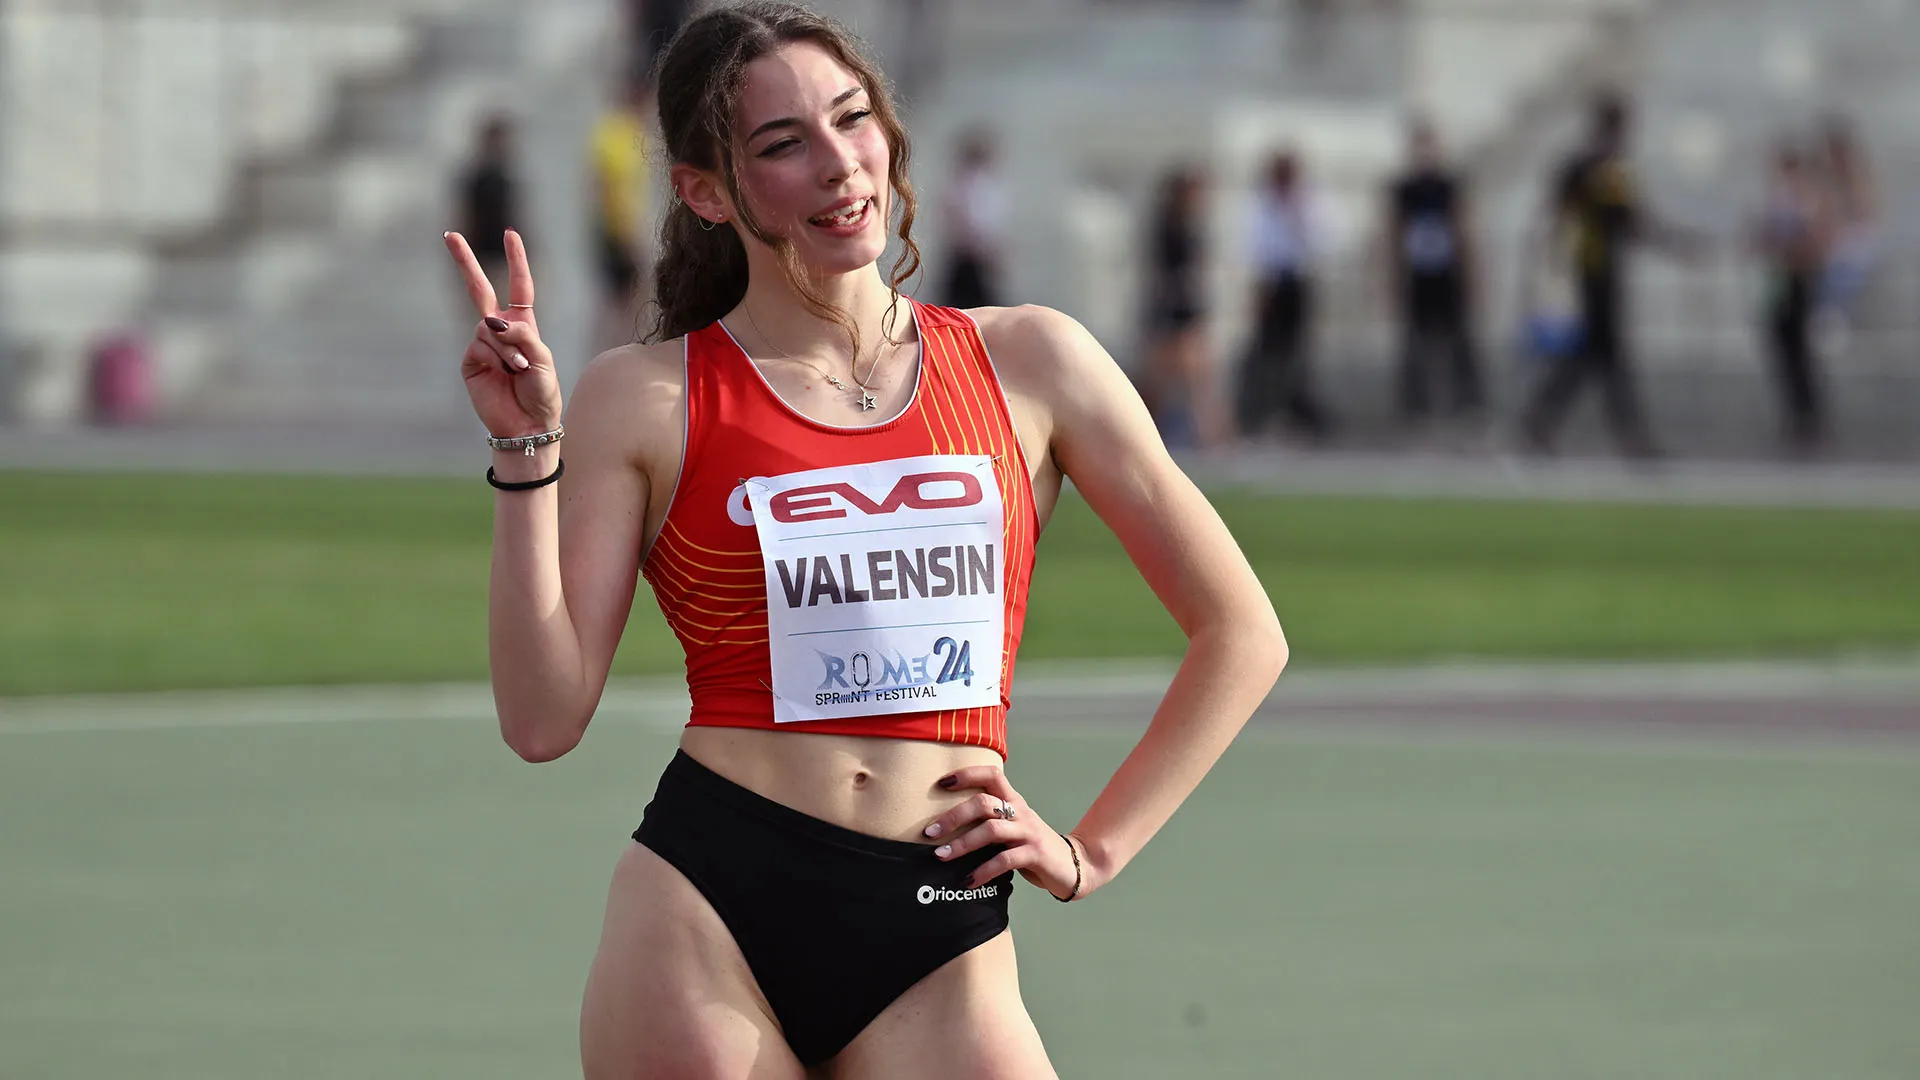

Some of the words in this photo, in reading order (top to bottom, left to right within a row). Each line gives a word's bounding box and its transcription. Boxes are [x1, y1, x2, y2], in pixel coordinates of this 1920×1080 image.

[769, 471, 983, 523] EVO
[774, 543, 995, 609] VALENSIN
[875, 685, 937, 702] FESTIVAL
[917, 885, 998, 905] Oriocenter
